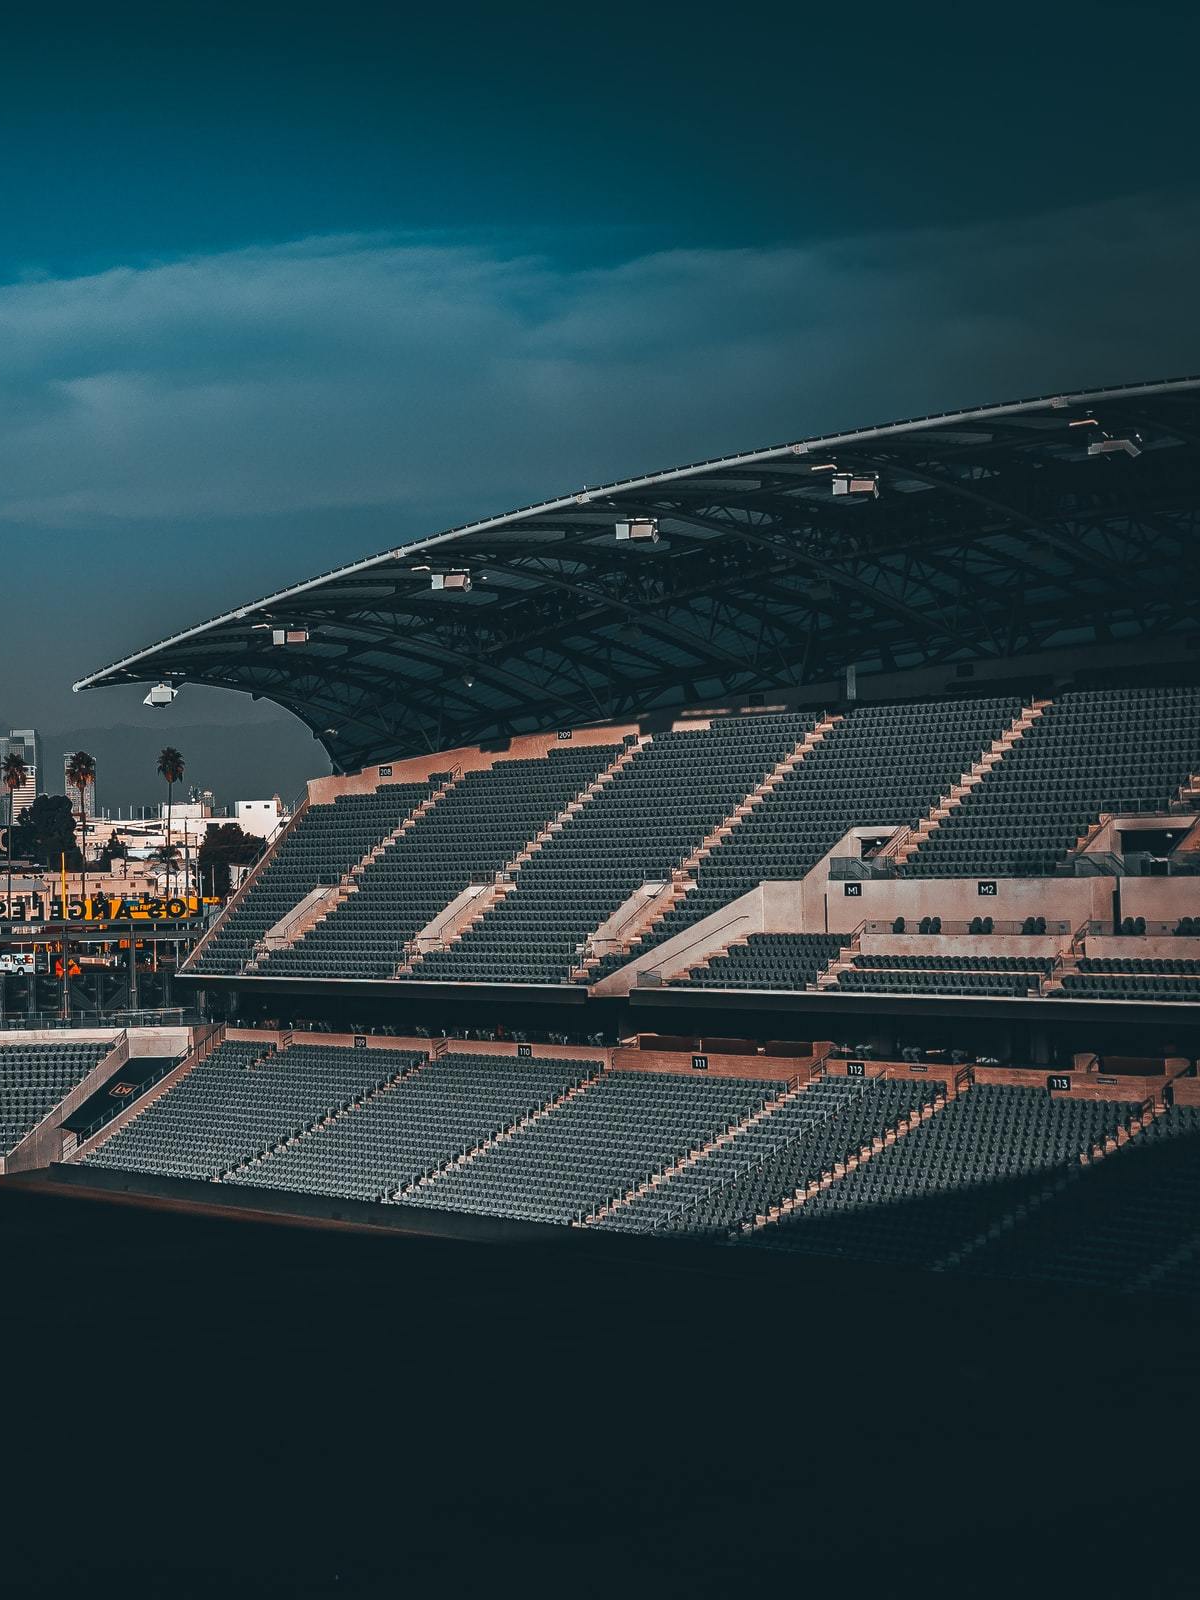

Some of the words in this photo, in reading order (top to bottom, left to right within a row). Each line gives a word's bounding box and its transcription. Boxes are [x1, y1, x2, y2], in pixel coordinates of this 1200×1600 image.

[559, 731, 571, 739] 209
[847, 886, 858, 895] M1
[980, 885, 994, 894] M2
[519, 1047, 531, 1056] 110
[694, 1058, 706, 1068] 111
[849, 1065, 863, 1075] 112
[1052, 1079, 1068, 1089] 113
